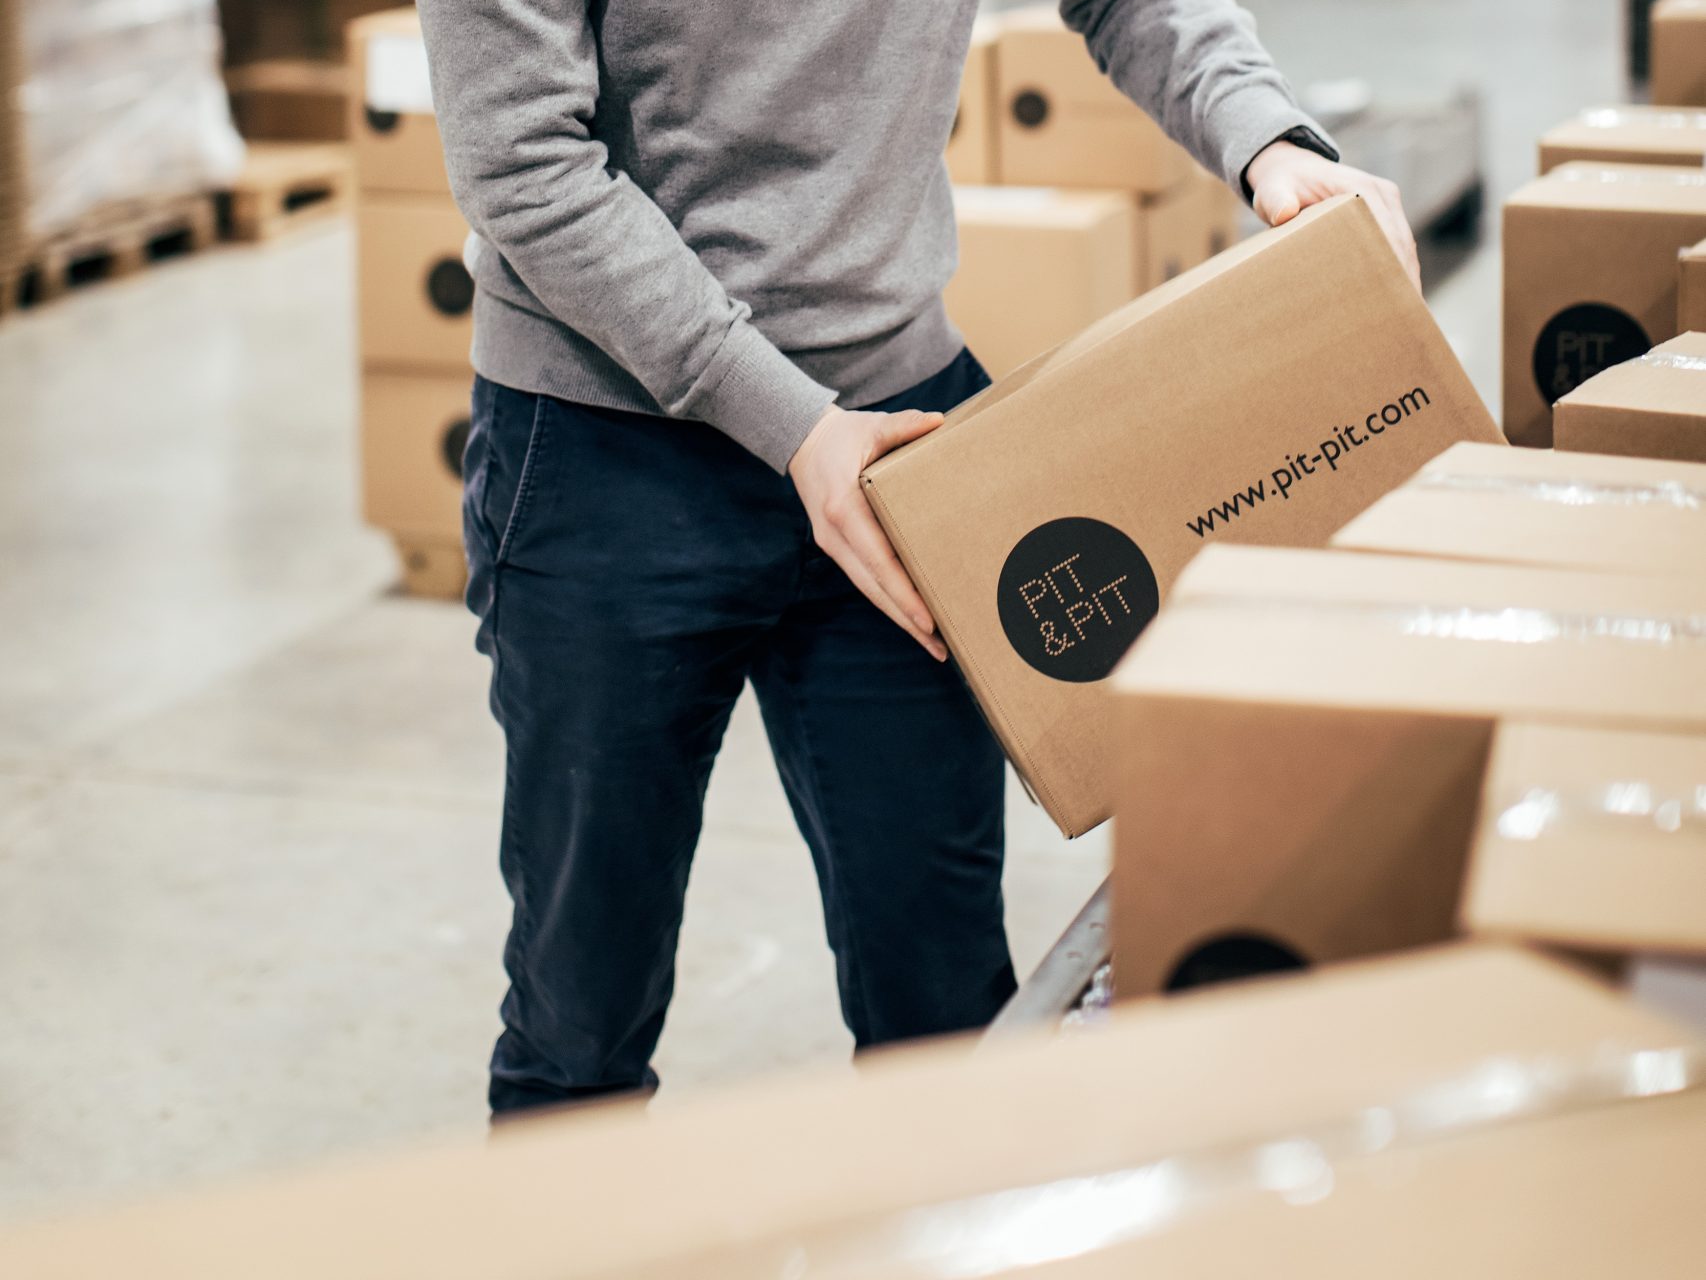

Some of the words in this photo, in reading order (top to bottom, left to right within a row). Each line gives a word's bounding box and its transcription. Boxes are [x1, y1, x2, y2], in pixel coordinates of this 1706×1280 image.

[1556, 330, 1614, 364] PIT
[1186, 385, 1431, 538] www.pit-pit.com
[1018, 552, 1084, 619] PIT
